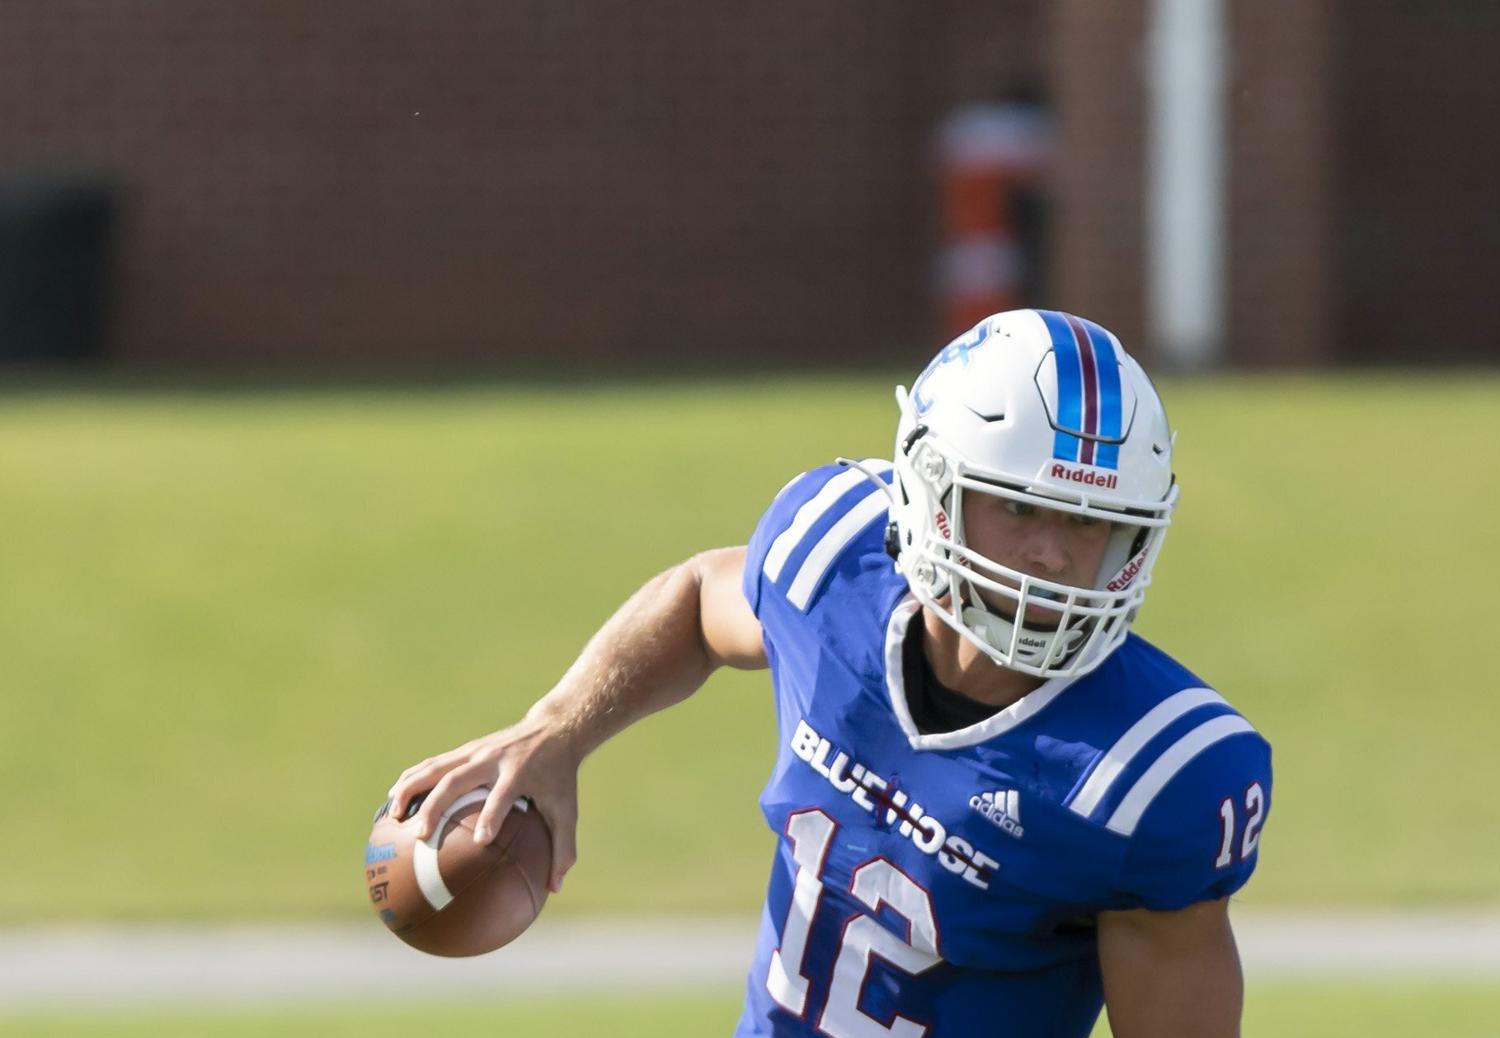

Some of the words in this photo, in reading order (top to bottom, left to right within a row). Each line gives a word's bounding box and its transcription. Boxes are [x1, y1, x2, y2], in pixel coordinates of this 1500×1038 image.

[1051, 464, 1118, 489] Riddell
[1018, 637, 1046, 648] iddell
[790, 719, 889, 812] BLUE
[886, 790, 1001, 890] HOSE
[969, 795, 1024, 839] adidas
[1214, 780, 1264, 869] 12
